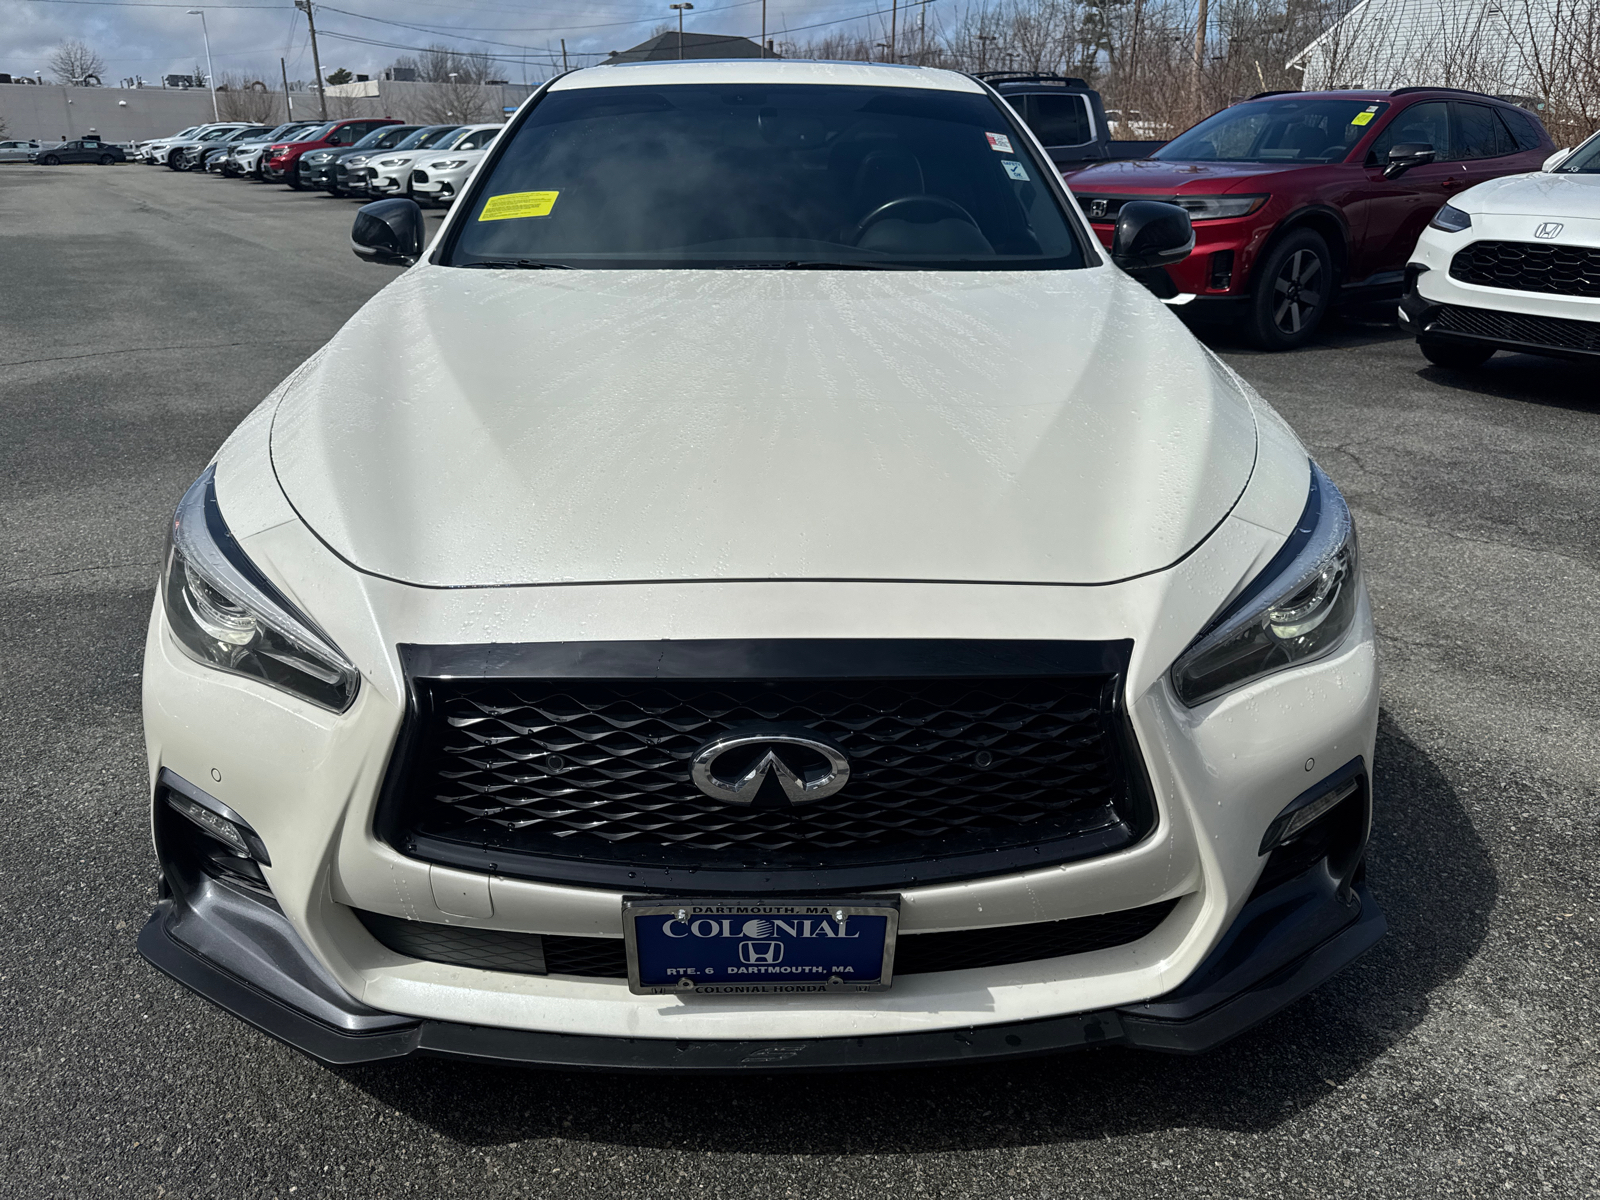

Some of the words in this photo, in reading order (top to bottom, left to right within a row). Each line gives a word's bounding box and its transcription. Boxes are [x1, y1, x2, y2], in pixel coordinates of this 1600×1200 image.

[692, 906, 800, 914] DARTMOUTH,
[805, 906, 830, 914] MA
[662, 919, 860, 939] COLONIAL
[666, 967, 701, 976] RTE.
[704, 967, 715, 975] 6
[727, 966, 827, 974] DARTMOUTH,
[831, 965, 855, 973] MA
[695, 986, 769, 994] COLONIAL
[773, 985, 827, 993] HONDA
